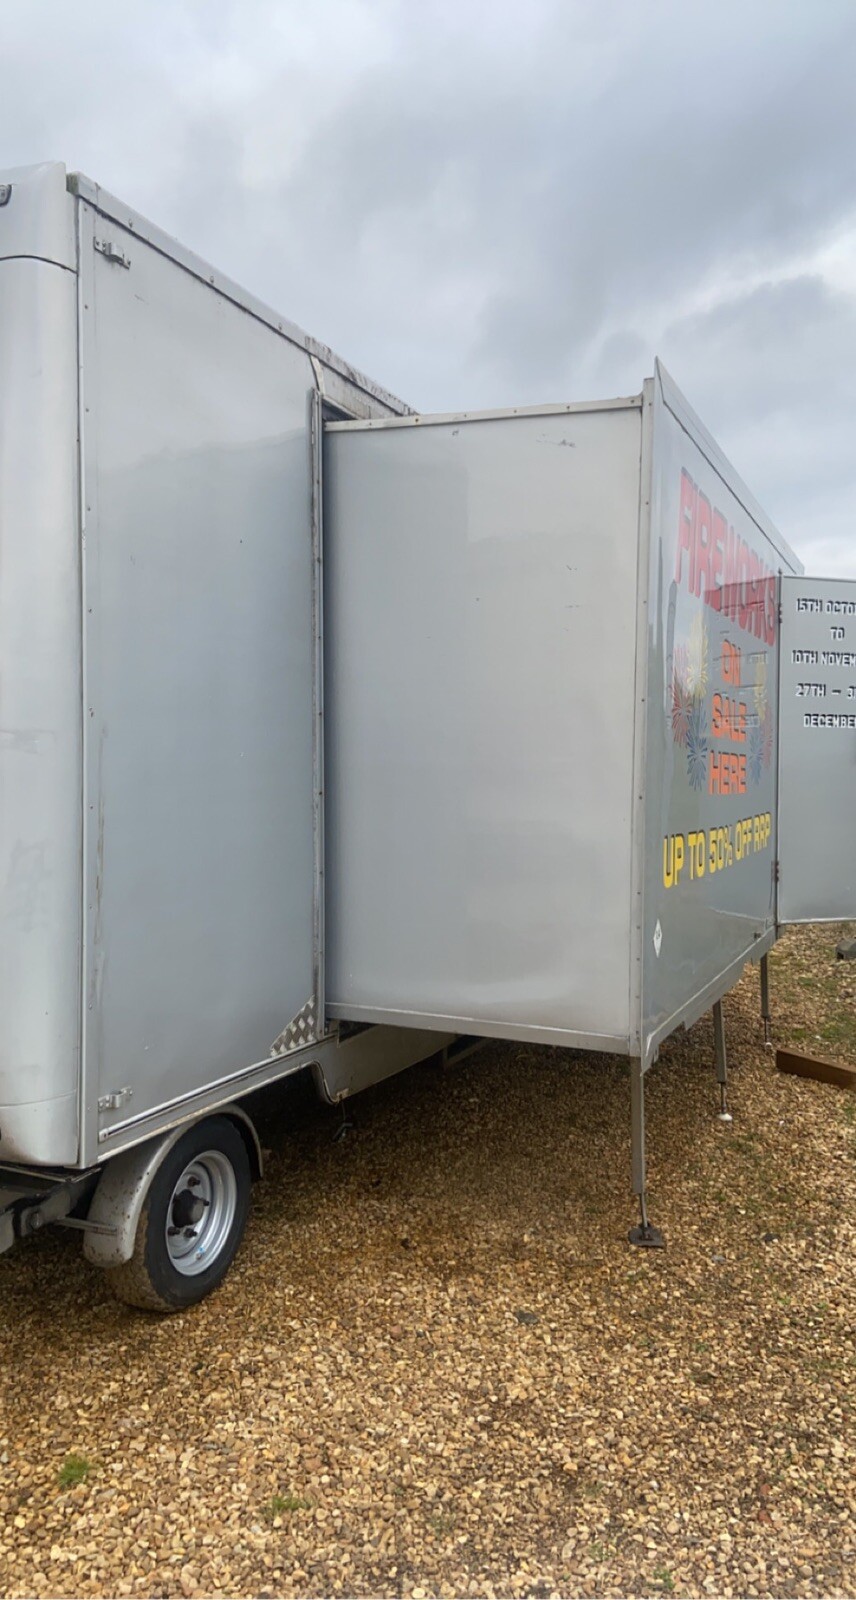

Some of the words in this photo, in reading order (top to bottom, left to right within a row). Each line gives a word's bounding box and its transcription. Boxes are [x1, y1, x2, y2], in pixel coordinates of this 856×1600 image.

[674, 466, 776, 647] FIREWORKS
[796, 598, 823, 613] 15TH
[826, 600, 856, 616] OCTO
[830, 626, 845, 641] TO
[722, 638, 741, 689] ON
[791, 650, 818, 665] 10TH
[795, 683, 826, 698] 27TH
[847, 685, 856, 700] 3
[711, 692, 747, 742] SALE
[803, 713, 856, 728] DECEMBE
[709, 750, 747, 795] HERE
[663, 834, 685, 889] UP
[688, 829, 706, 880] TO
[709, 824, 733, 874] 50%
[735, 816, 753, 860] OFF
[754, 811, 772, 853] RRP
